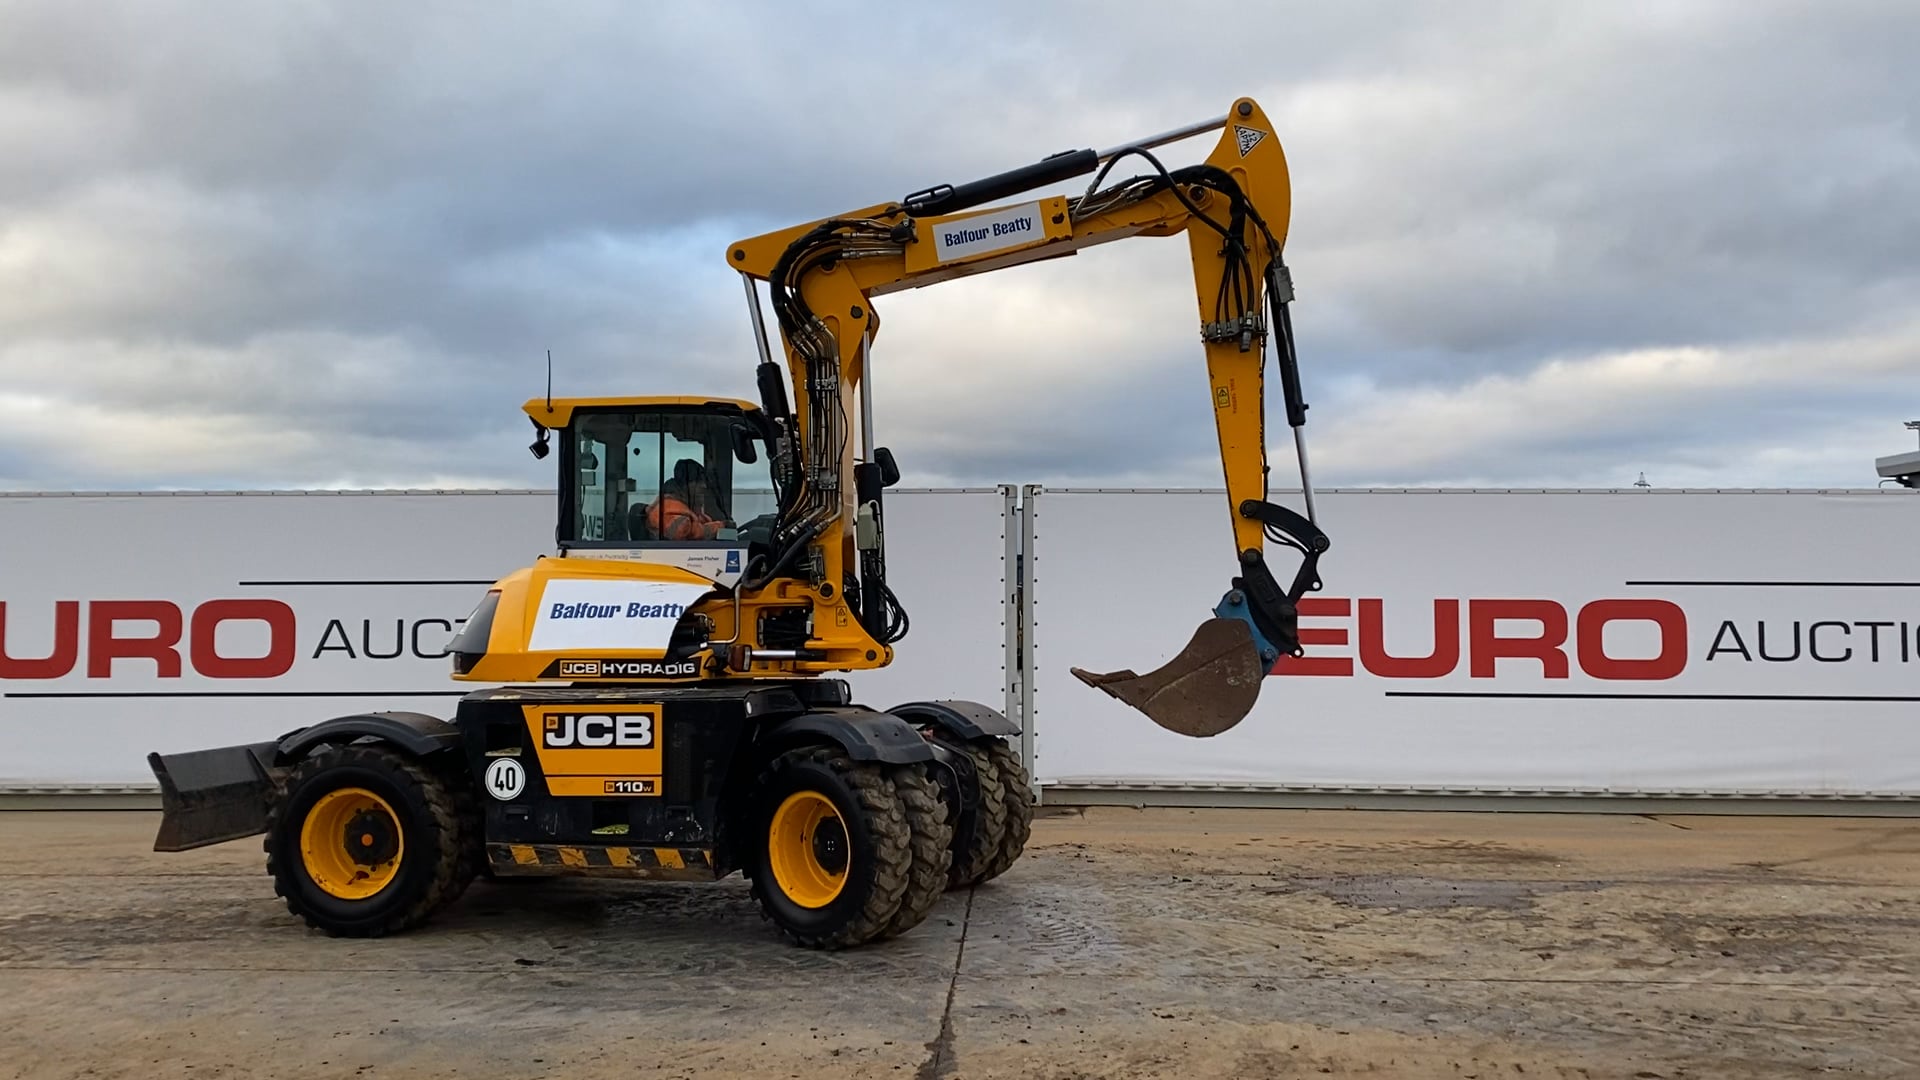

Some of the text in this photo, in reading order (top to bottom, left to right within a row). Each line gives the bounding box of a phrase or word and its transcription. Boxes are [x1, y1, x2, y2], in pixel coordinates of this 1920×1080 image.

[945, 217, 1032, 247] Balfour Beatty
[551, 602, 621, 619] Balfour
[312, 618, 468, 659] AUC
[1268, 598, 1920, 680] EURO AUCTI
[562, 662, 695, 675] JCB HYDRADIG
[546, 715, 652, 746] JCB
[494, 766, 516, 791] 40
